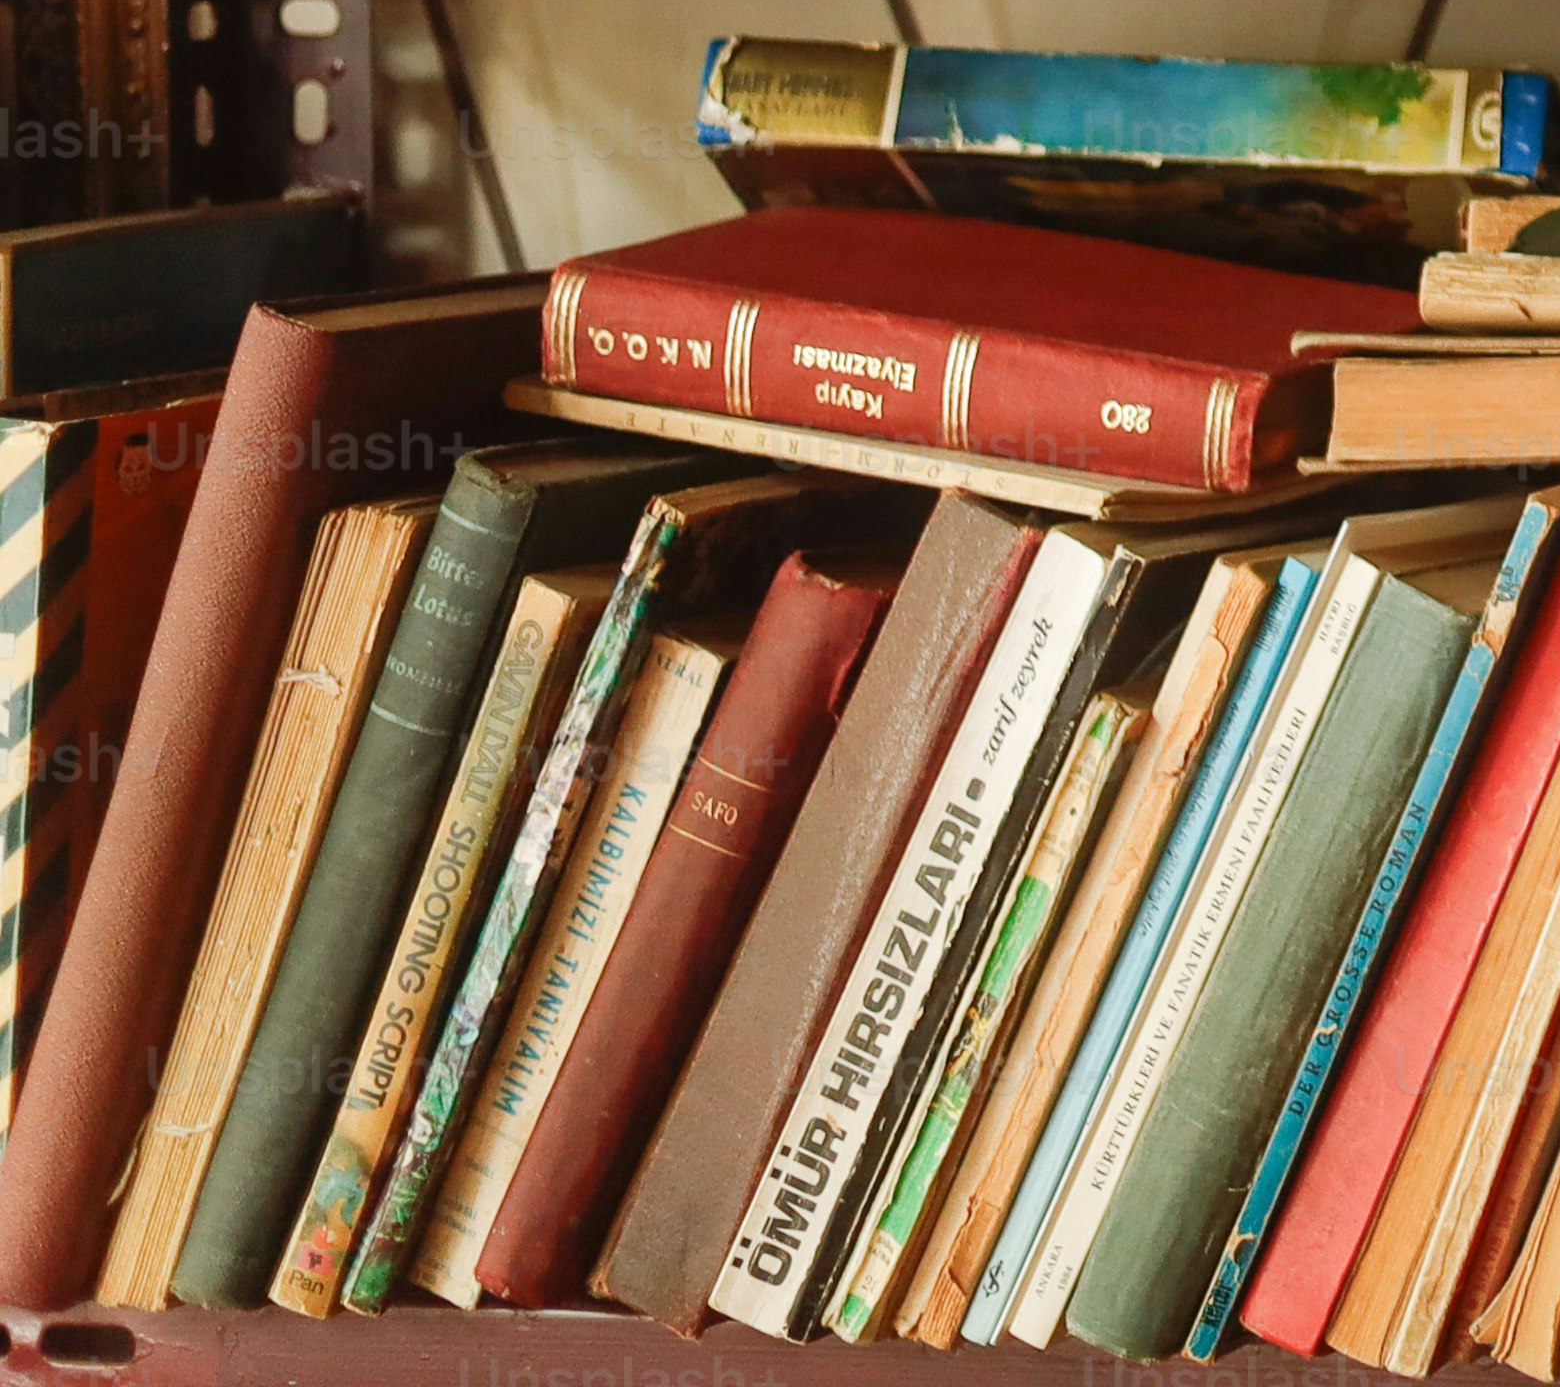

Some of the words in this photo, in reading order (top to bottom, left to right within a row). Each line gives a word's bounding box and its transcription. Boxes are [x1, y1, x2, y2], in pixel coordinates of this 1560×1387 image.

[813, 383, 883, 419] Kayıp
[1100, 400, 1152, 433] 280
[691, 790, 739, 824] SAFO
[398, 824, 481, 997] SHOOTING
[570, 782, 647, 943] KALBİMİZİ
[731, 1115, 848, 1286] ÖMÜR
[815, 794, 980, 1111] HIRSIZLARI
[981, 687, 1019, 767] zarif
[1008, 615, 1053, 700] zeyrek
[364, 1002, 416, 1110] SCRIPT
[494, 950, 578, 1116] TANIYALIM
[287, 1268, 325, 1294] Pan
